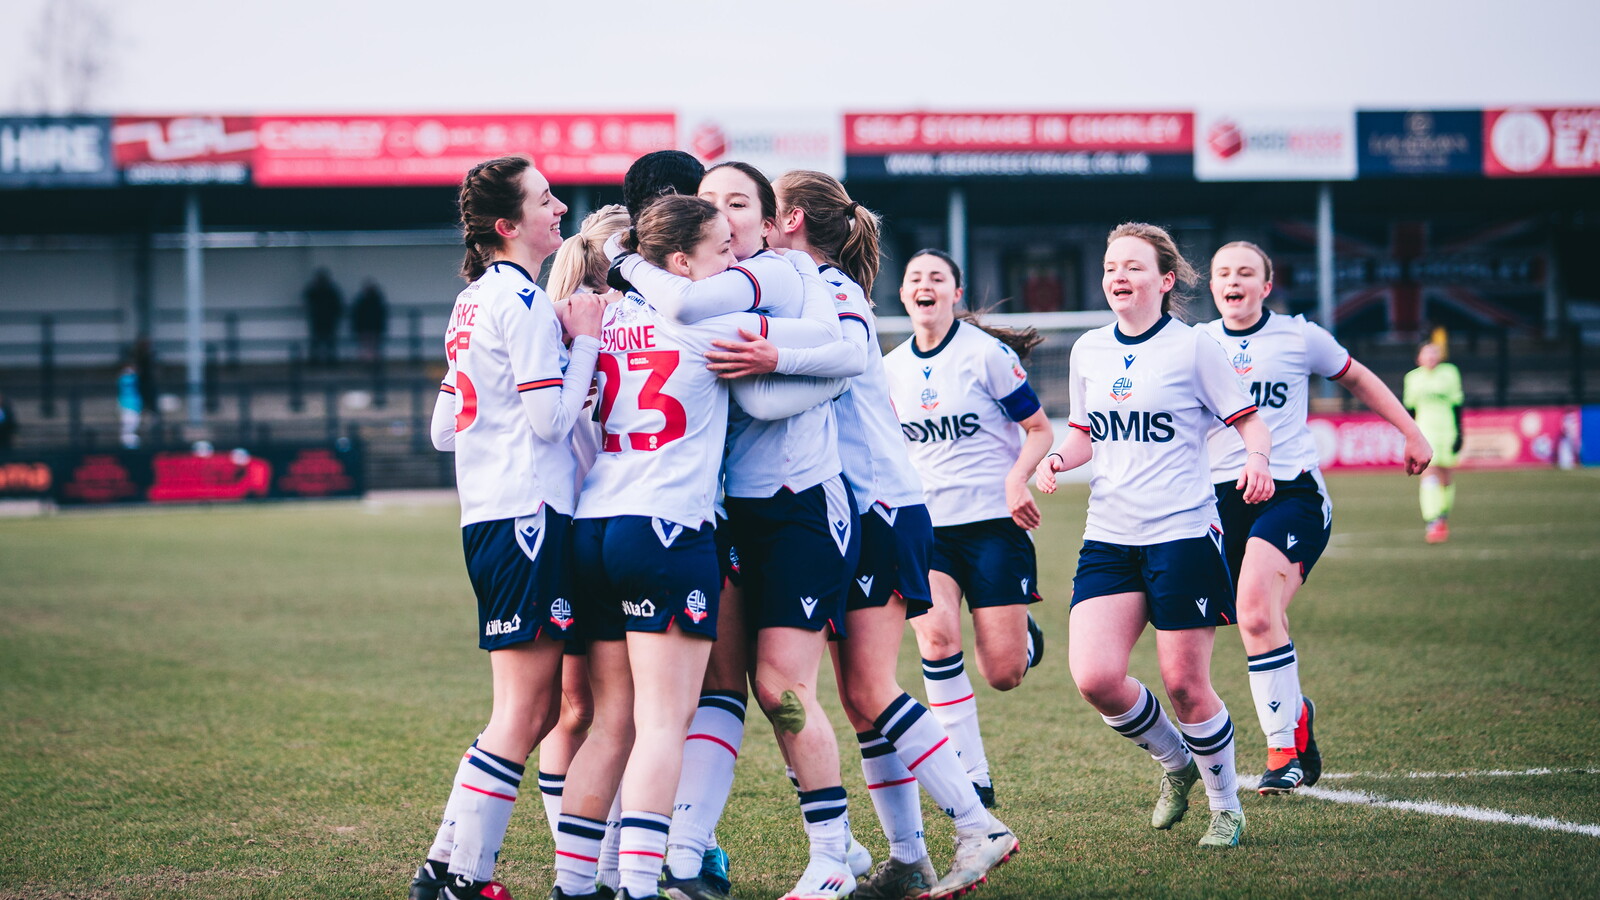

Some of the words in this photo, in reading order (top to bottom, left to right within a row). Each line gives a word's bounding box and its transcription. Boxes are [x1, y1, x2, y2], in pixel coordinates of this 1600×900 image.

[2, 125, 100, 172] HIRE
[854, 115, 916, 144] SELF
[921, 115, 1032, 144] STORAGE
[1036, 115, 1066, 143] IN
[1069, 114, 1183, 143] CHORLEY
[597, 350, 687, 452] 23
